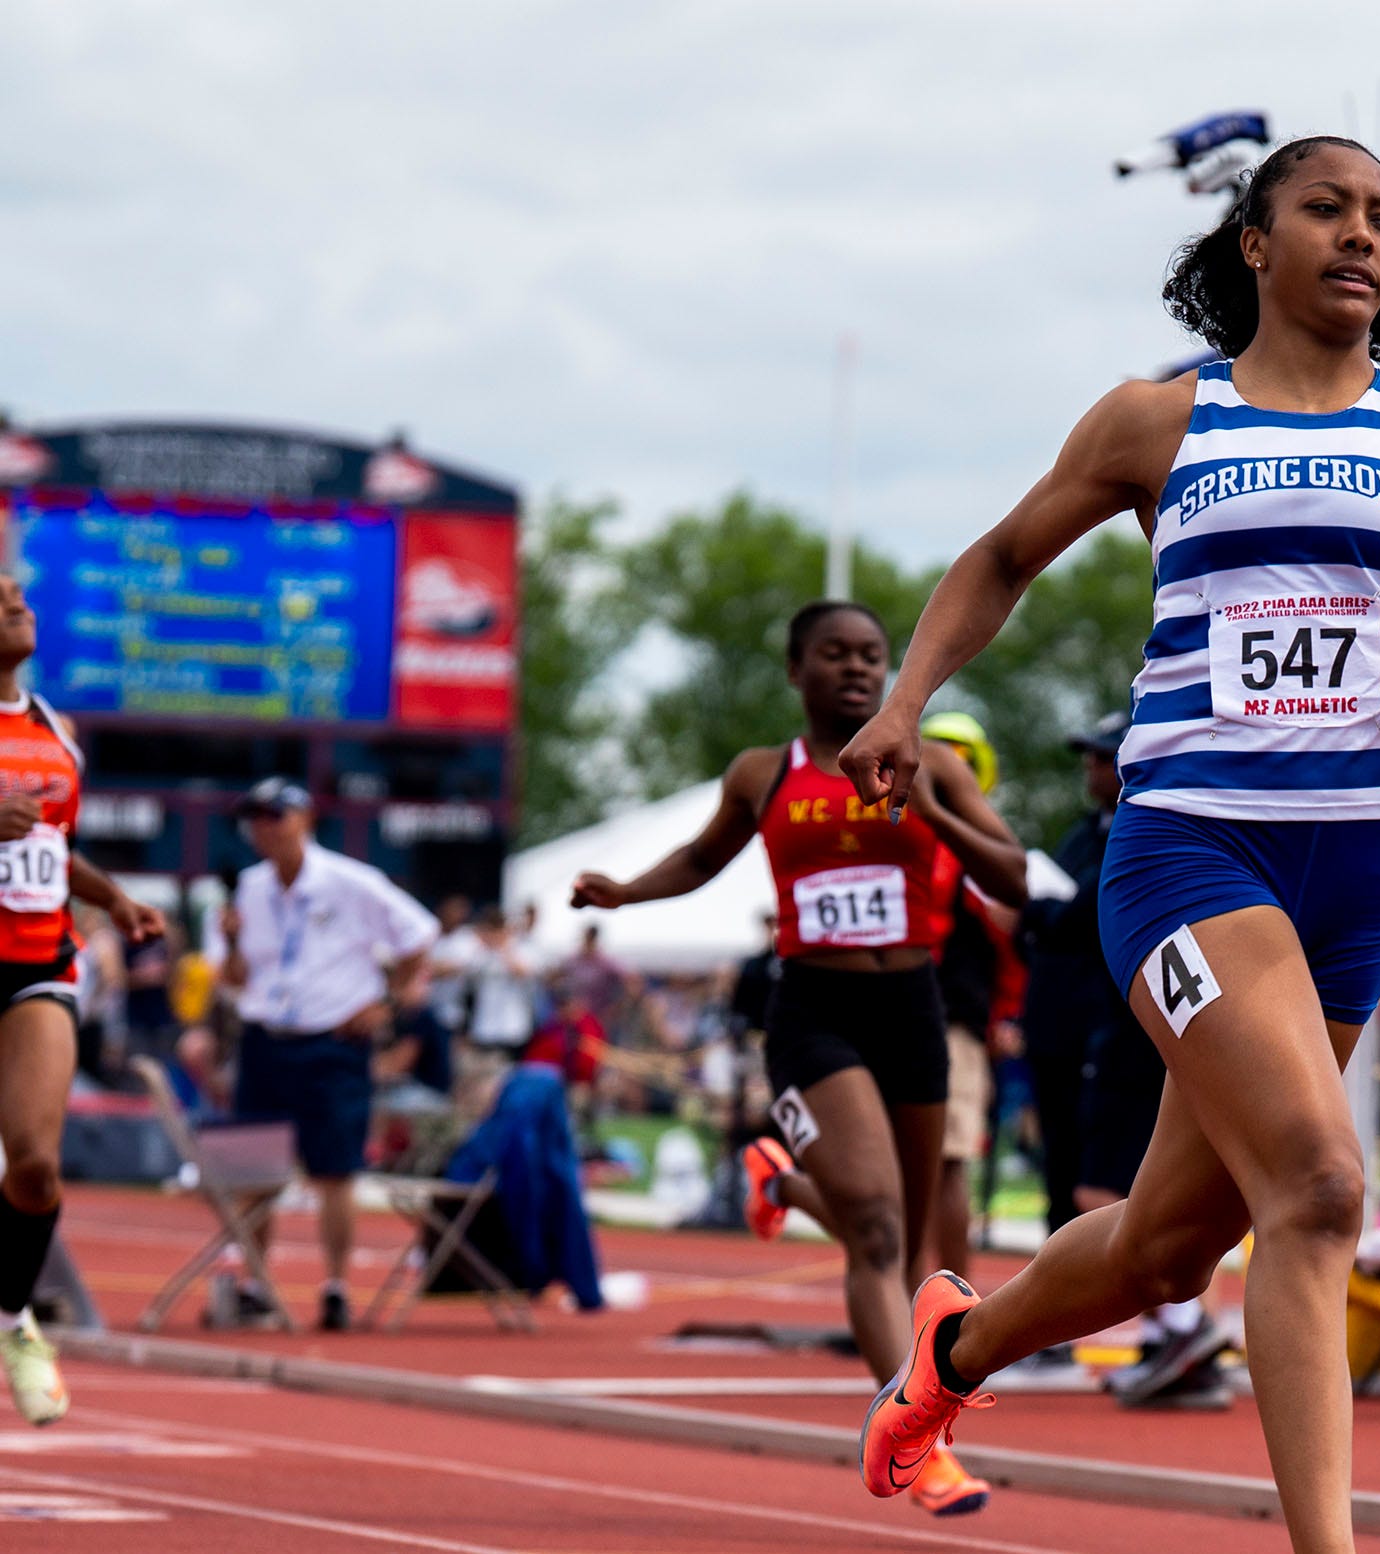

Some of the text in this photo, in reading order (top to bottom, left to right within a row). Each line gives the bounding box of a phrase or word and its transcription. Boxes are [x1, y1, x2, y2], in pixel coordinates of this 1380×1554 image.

[1180, 457, 1301, 525] SPRING
[1224, 596, 1371, 618] 2022 PIAA AAA GIRLS
[1228, 612, 1256, 622] TRACK
[1267, 609, 1291, 618] FIELD
[1293, 608, 1368, 617] CHAMPIONSHIPS
[1241, 627, 1357, 691] 547
[1244, 696, 1358, 716] MF ATHLETIC
[816, 887, 887, 930] 614
[1160, 939, 1204, 1016] 4
[780, 1100, 807, 1148] 2
